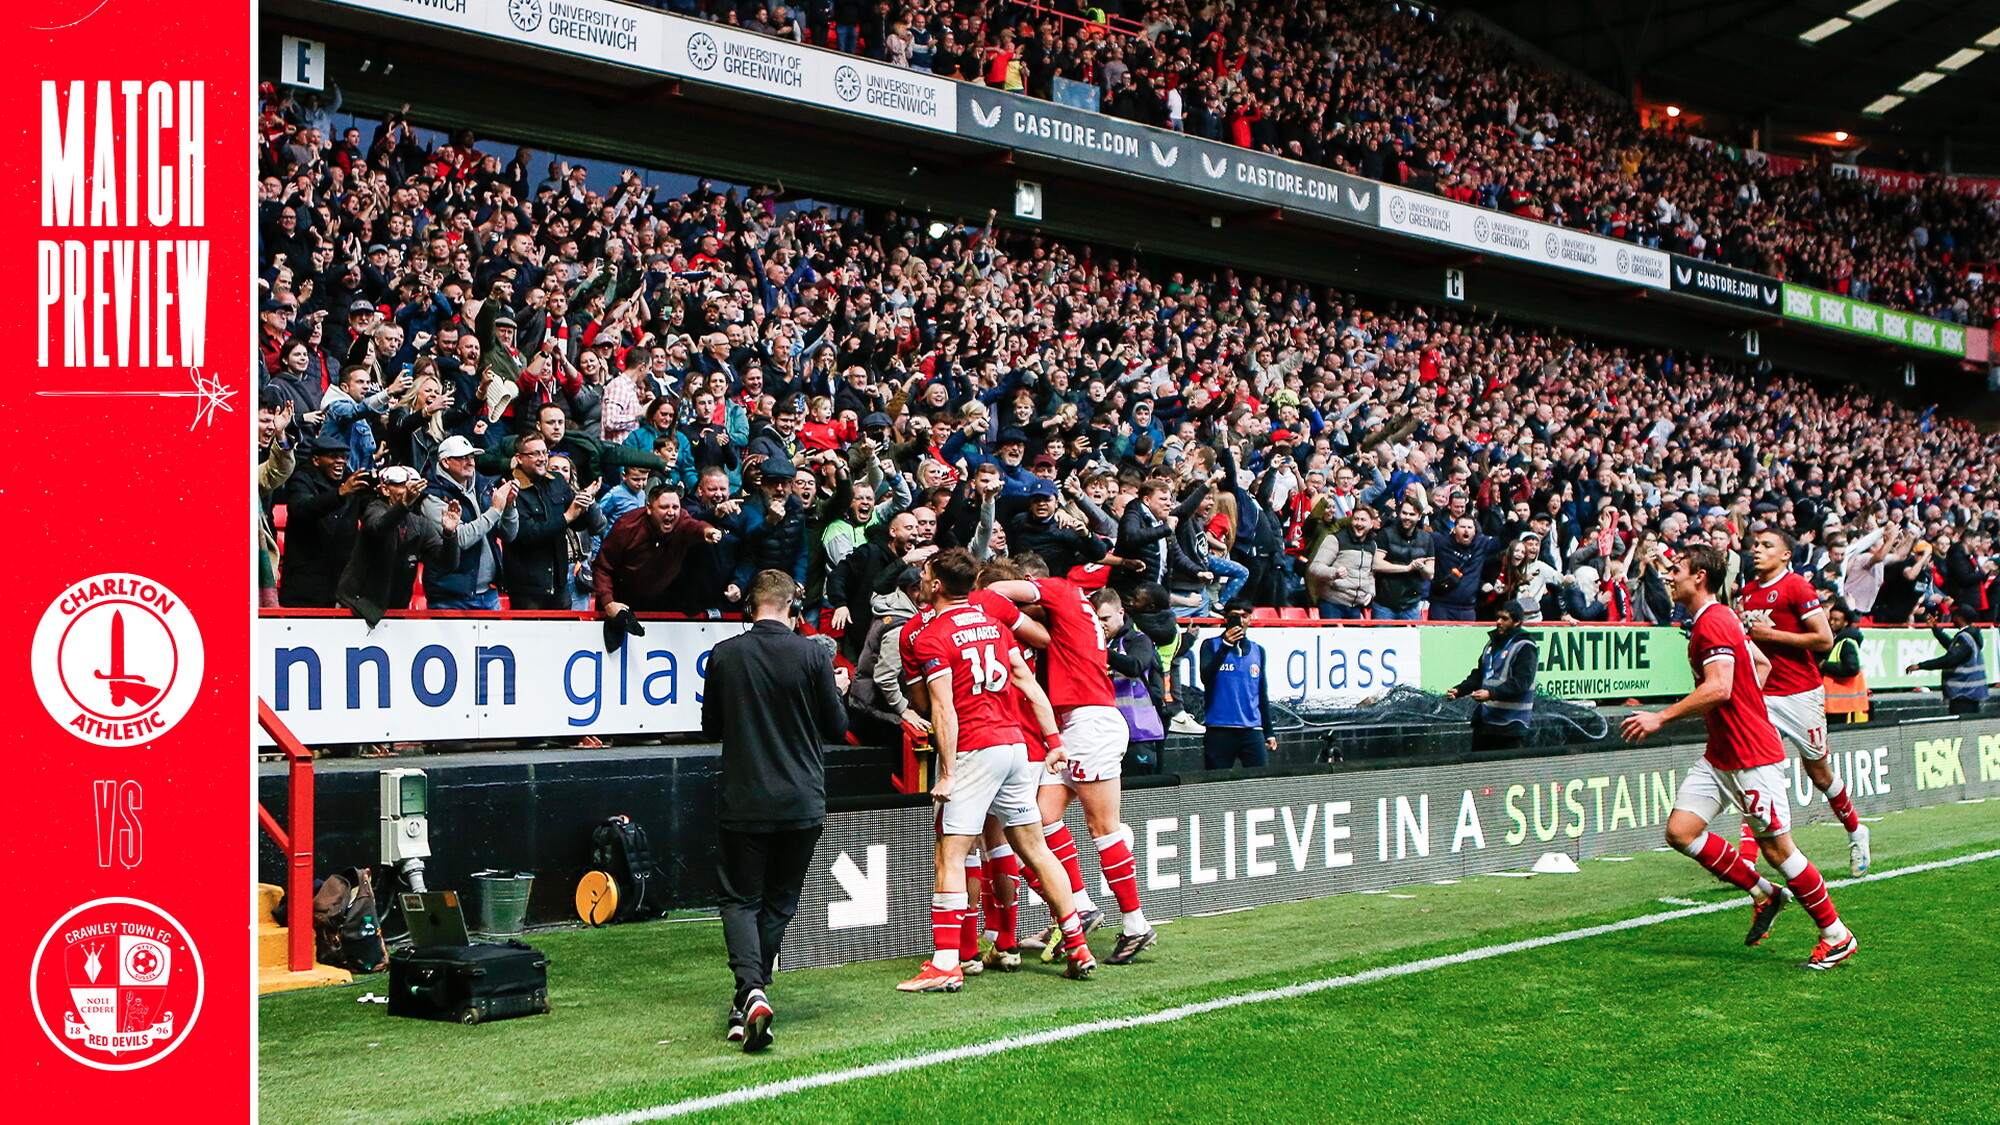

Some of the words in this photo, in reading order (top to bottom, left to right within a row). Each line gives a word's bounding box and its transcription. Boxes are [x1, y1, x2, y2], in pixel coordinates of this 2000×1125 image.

[549, 3, 620, 30] UNIVERSITY
[622, 18, 637, 32] OF
[548, 18, 637, 52] GREENWICH
[297, 41, 311, 84] E
[724, 41, 784, 65] UNIVERSITY
[787, 56, 801, 70] OF
[723, 57, 802, 88] GREENWICH
[867, 74, 921, 96] UNIVERSITY
[923, 87, 936, 100] OF
[866, 88, 937, 117] GREENWICH
[1013, 111, 1139, 158] CASTORE.COM
[1237, 163, 1339, 203] CASTORE.COM
[1408, 213, 1451, 232] GREENWICH
[1409, 202, 1441, 217] UNIVERSITY
[1442, 209, 1449, 219] OF
[1491, 221, 1521, 236] UNIVERSITY
[1522, 229, 1530, 238] OF
[1491, 232, 1530, 251] GREENWICH
[1561, 238, 1589, 251] UNIVERSITY
[1590, 245, 1596, 253] OF
[1561, 249, 1597, 265] GREENWICH
[1451, 271, 1460, 296] C
[1697, 271, 1759, 299] CASTORE.COM
[1786, 289, 1814, 318] RSK
[1819, 297, 1847, 325] RSK
[1851, 305, 1878, 332] RSK
[1882, 313, 1907, 340] RSK
[1912, 320, 1936, 346] RSK
[1941, 327, 1963, 352] RSK
[951, 625, 1000, 647] EDWARDS
[961, 644, 1008, 695] 16
[1287, 635, 1398, 700] glass
[1547, 679, 1611, 695] GREENWICH
[1613, 680, 1650, 690] COMPANY
[1807, 726, 1822, 745] 11
[1914, 737, 1967, 791] RSK
[1377, 794, 1429, 861] IN
[1451, 789, 1486, 852] A
[1505, 767, 1694, 846] SUSTAIN
